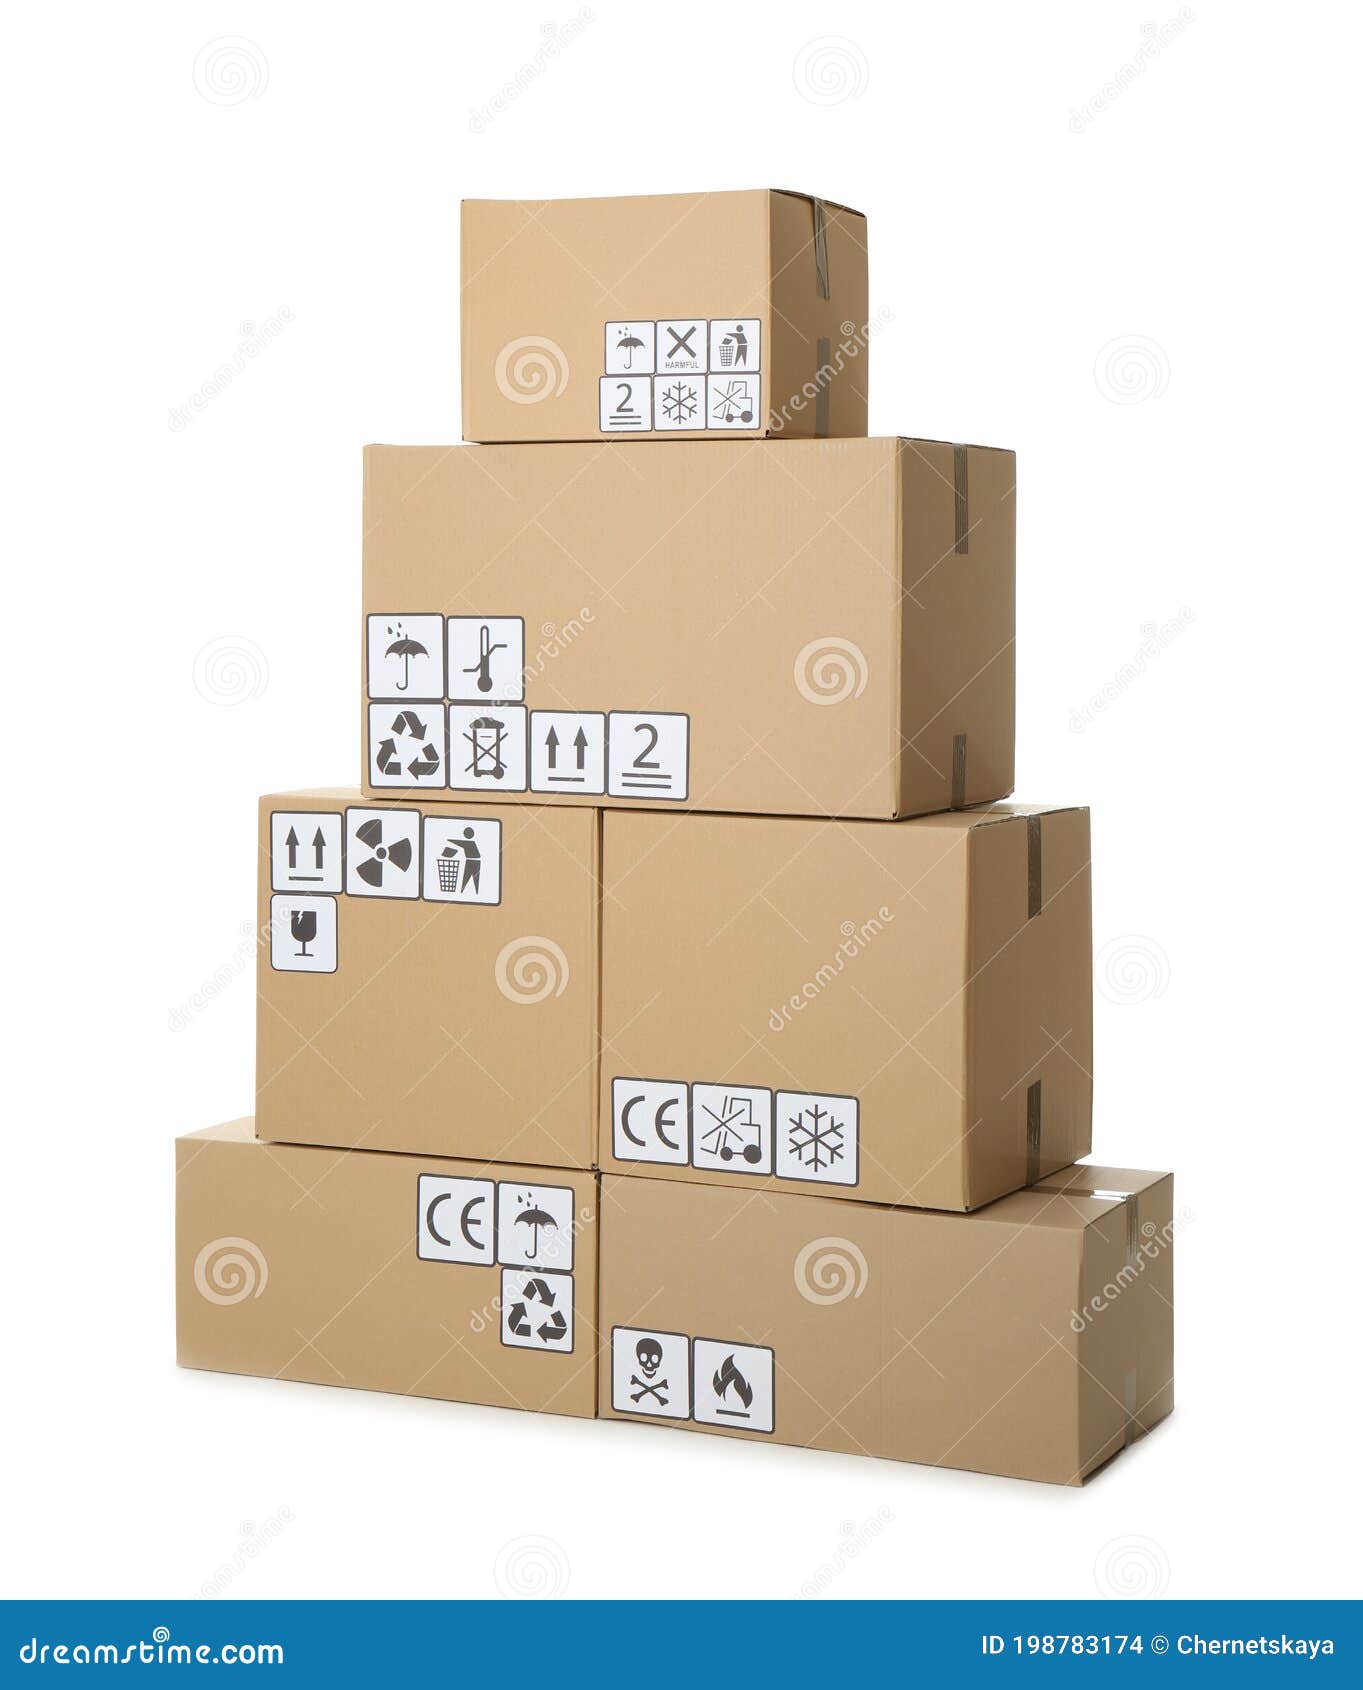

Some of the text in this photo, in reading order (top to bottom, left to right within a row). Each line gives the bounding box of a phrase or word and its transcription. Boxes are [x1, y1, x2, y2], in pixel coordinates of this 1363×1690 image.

[665, 361, 699, 369] HARMFUL
[616, 383, 634, 412] 2
[633, 723, 660, 769] 2
[621, 1095, 680, 1150] CE
[427, 1193, 485, 1250] CE
